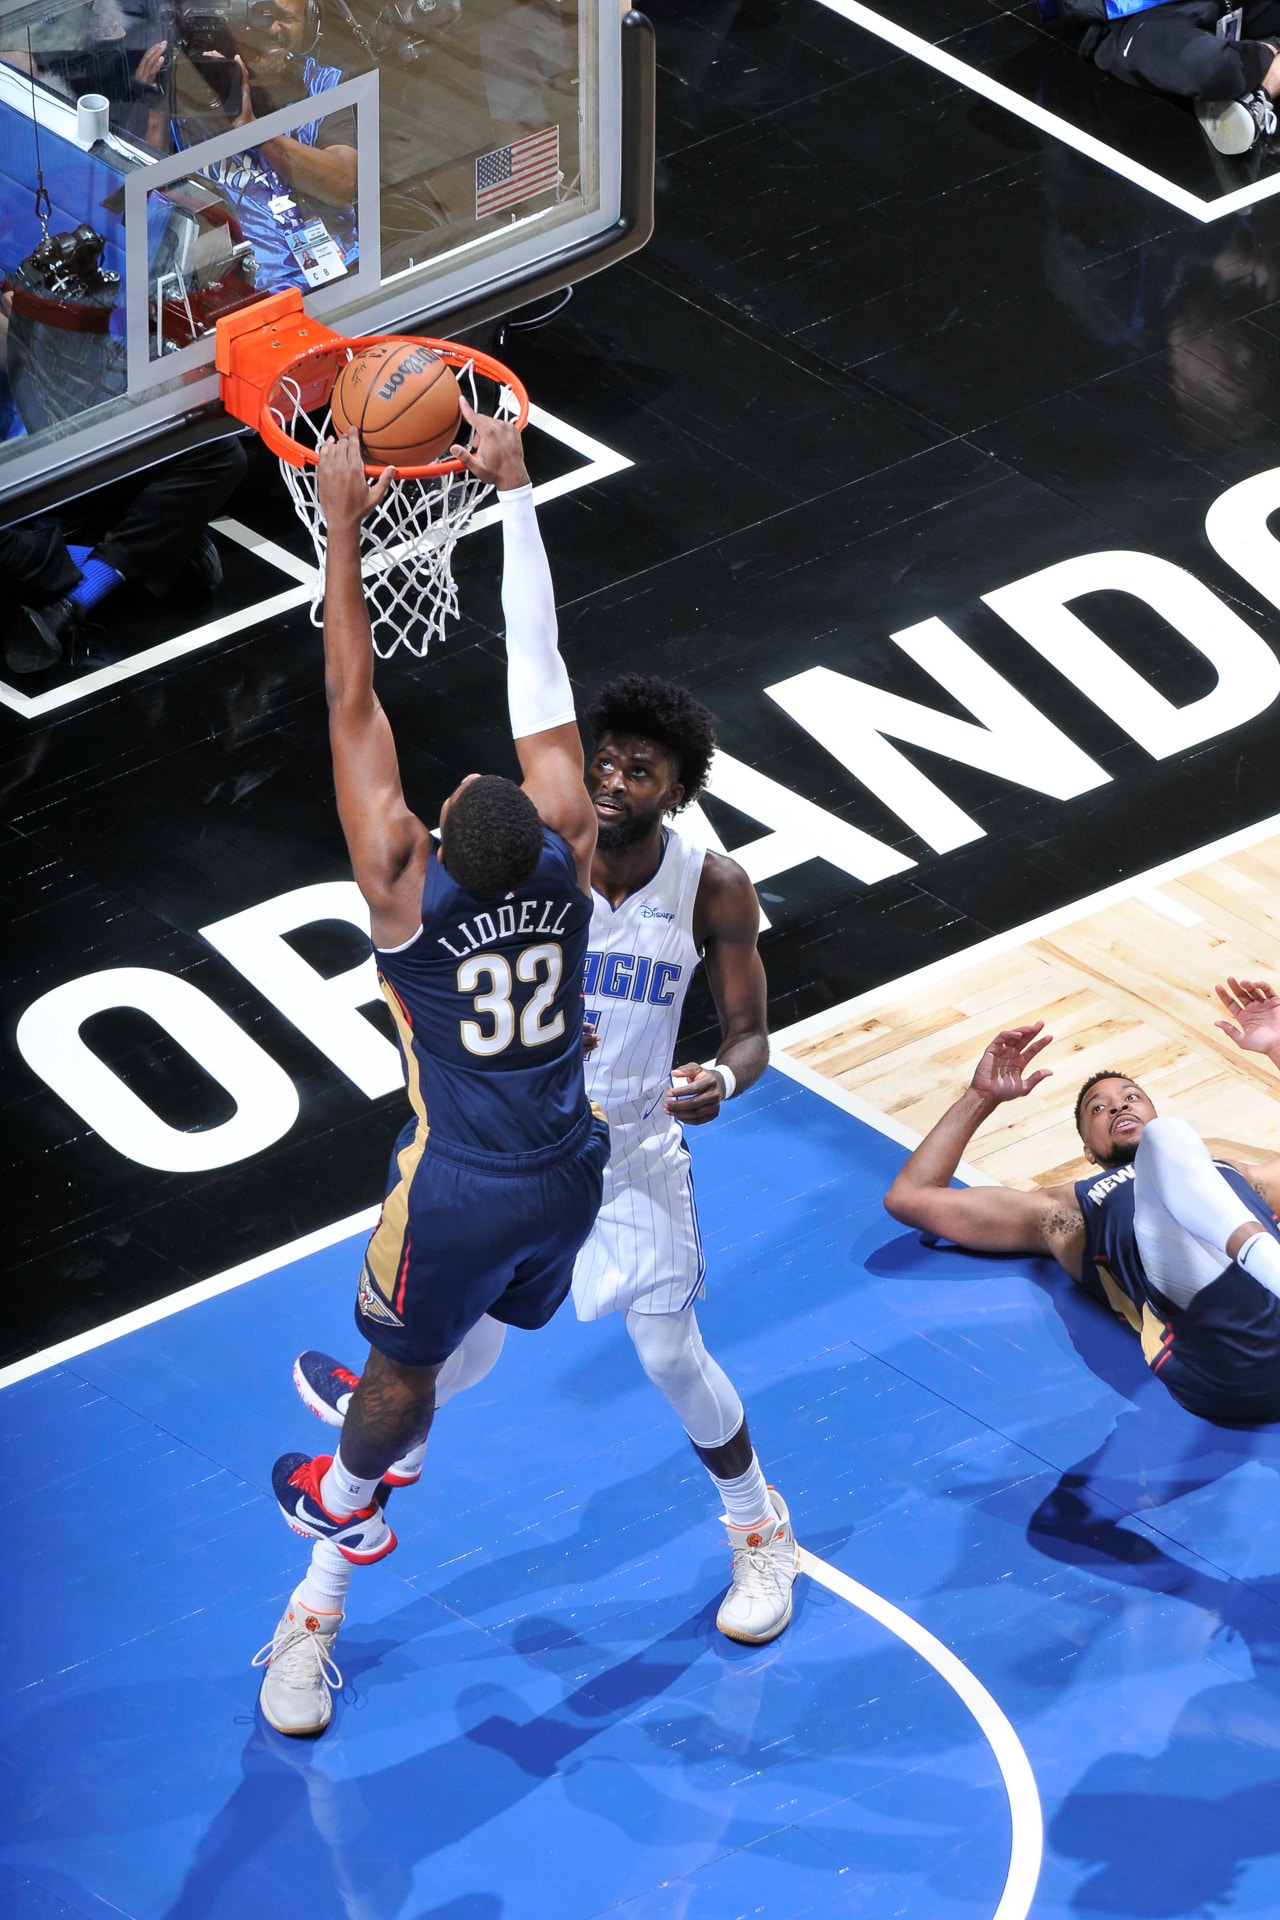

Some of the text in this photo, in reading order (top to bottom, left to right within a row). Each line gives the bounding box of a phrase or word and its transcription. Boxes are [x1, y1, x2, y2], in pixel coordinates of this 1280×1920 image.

[378, 347, 441, 401] Wilson
[16, 466, 1280, 1172] ORAND
[437, 900, 573, 957] LIDDELL
[640, 905, 675, 923] Disney
[457, 942, 566, 1057] 32
[583, 951, 682, 1006] AGIC
[1087, 1164, 1136, 1207] NEW
